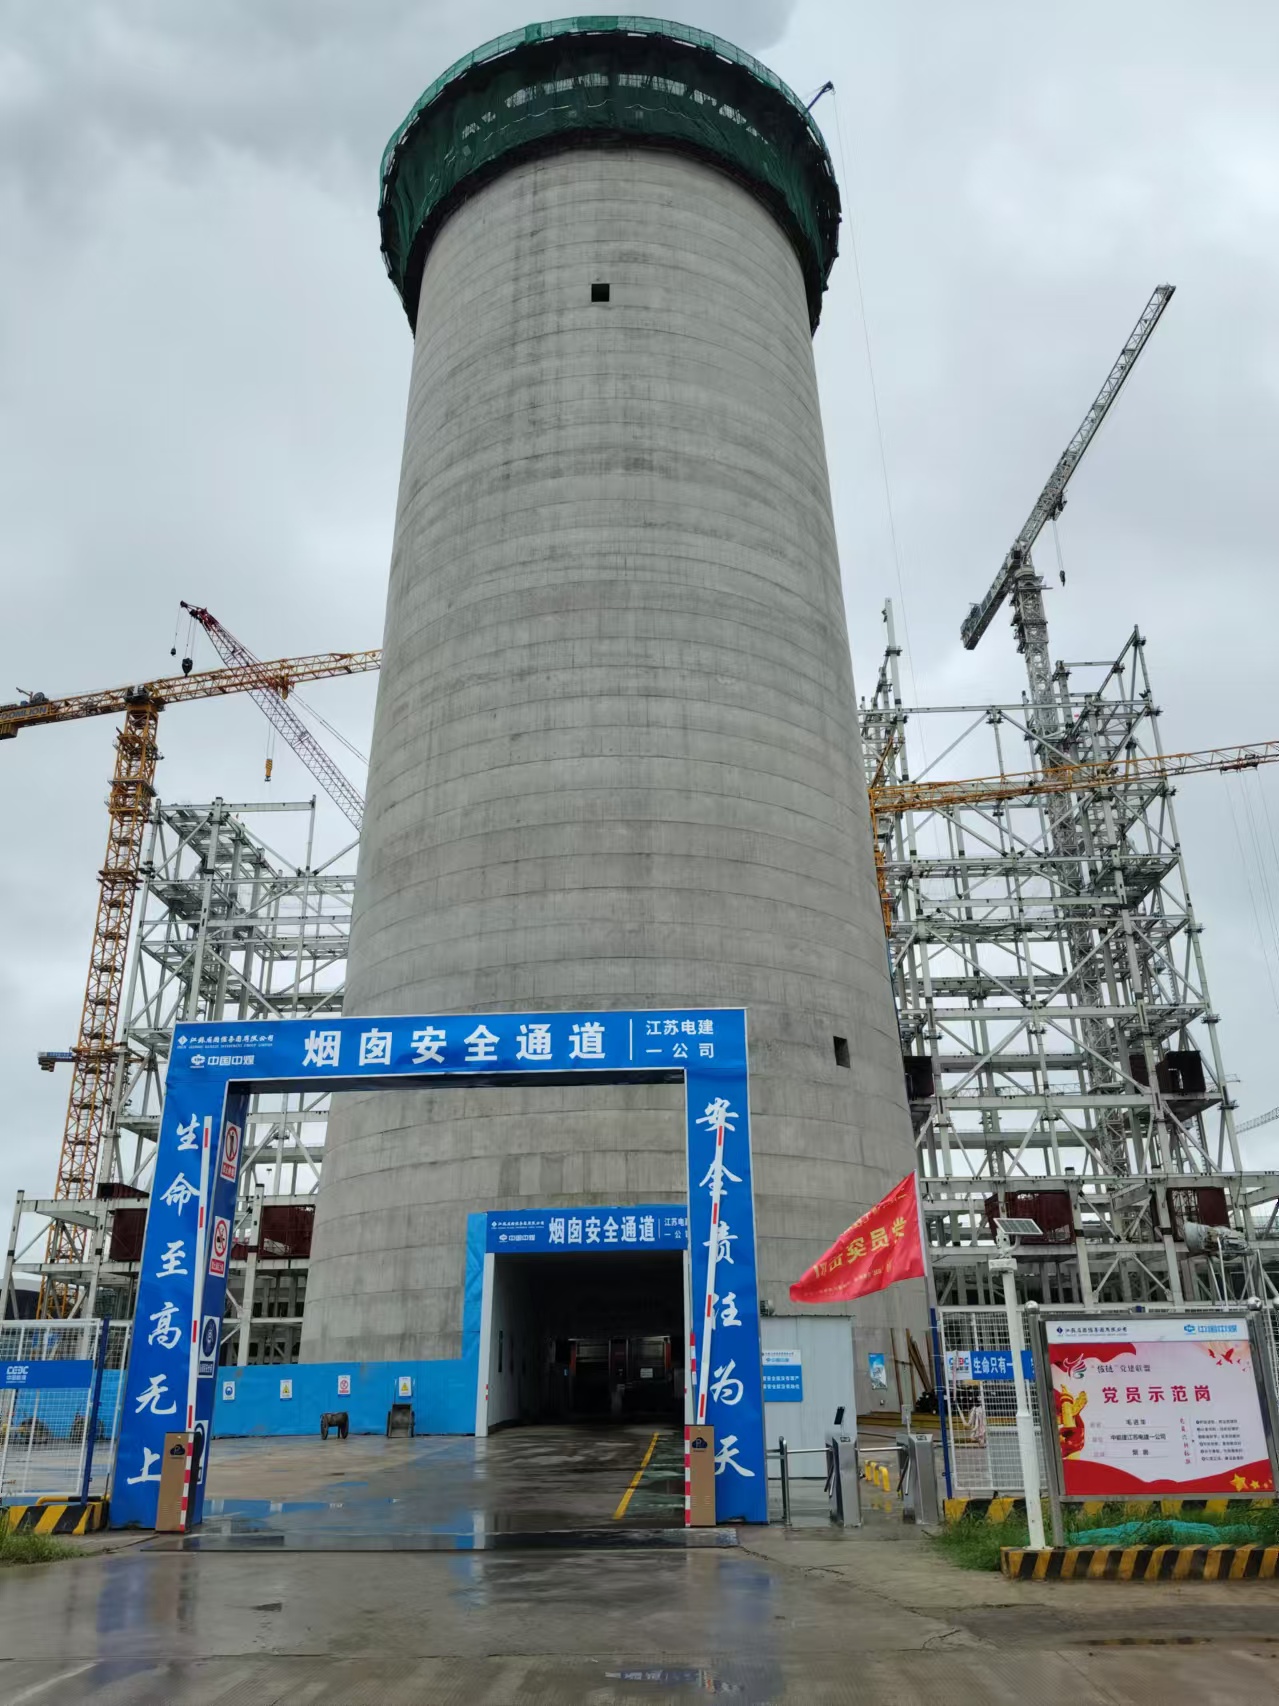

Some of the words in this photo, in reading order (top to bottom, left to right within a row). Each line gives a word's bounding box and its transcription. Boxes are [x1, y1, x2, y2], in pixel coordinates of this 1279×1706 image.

[645, 1019, 714, 1036] 江苏电建
[302, 1021, 606, 1068] 烟囱安全通道
[645, 1042, 714, 1059] 一公司
[207, 1055, 255, 1066] 中国中煤
[548, 1215, 656, 1244] 烟囱安全通道
[126, 1113, 200, 1485] 生命至高无上
[1102, 1385, 1211, 1404] 党员示范岗
